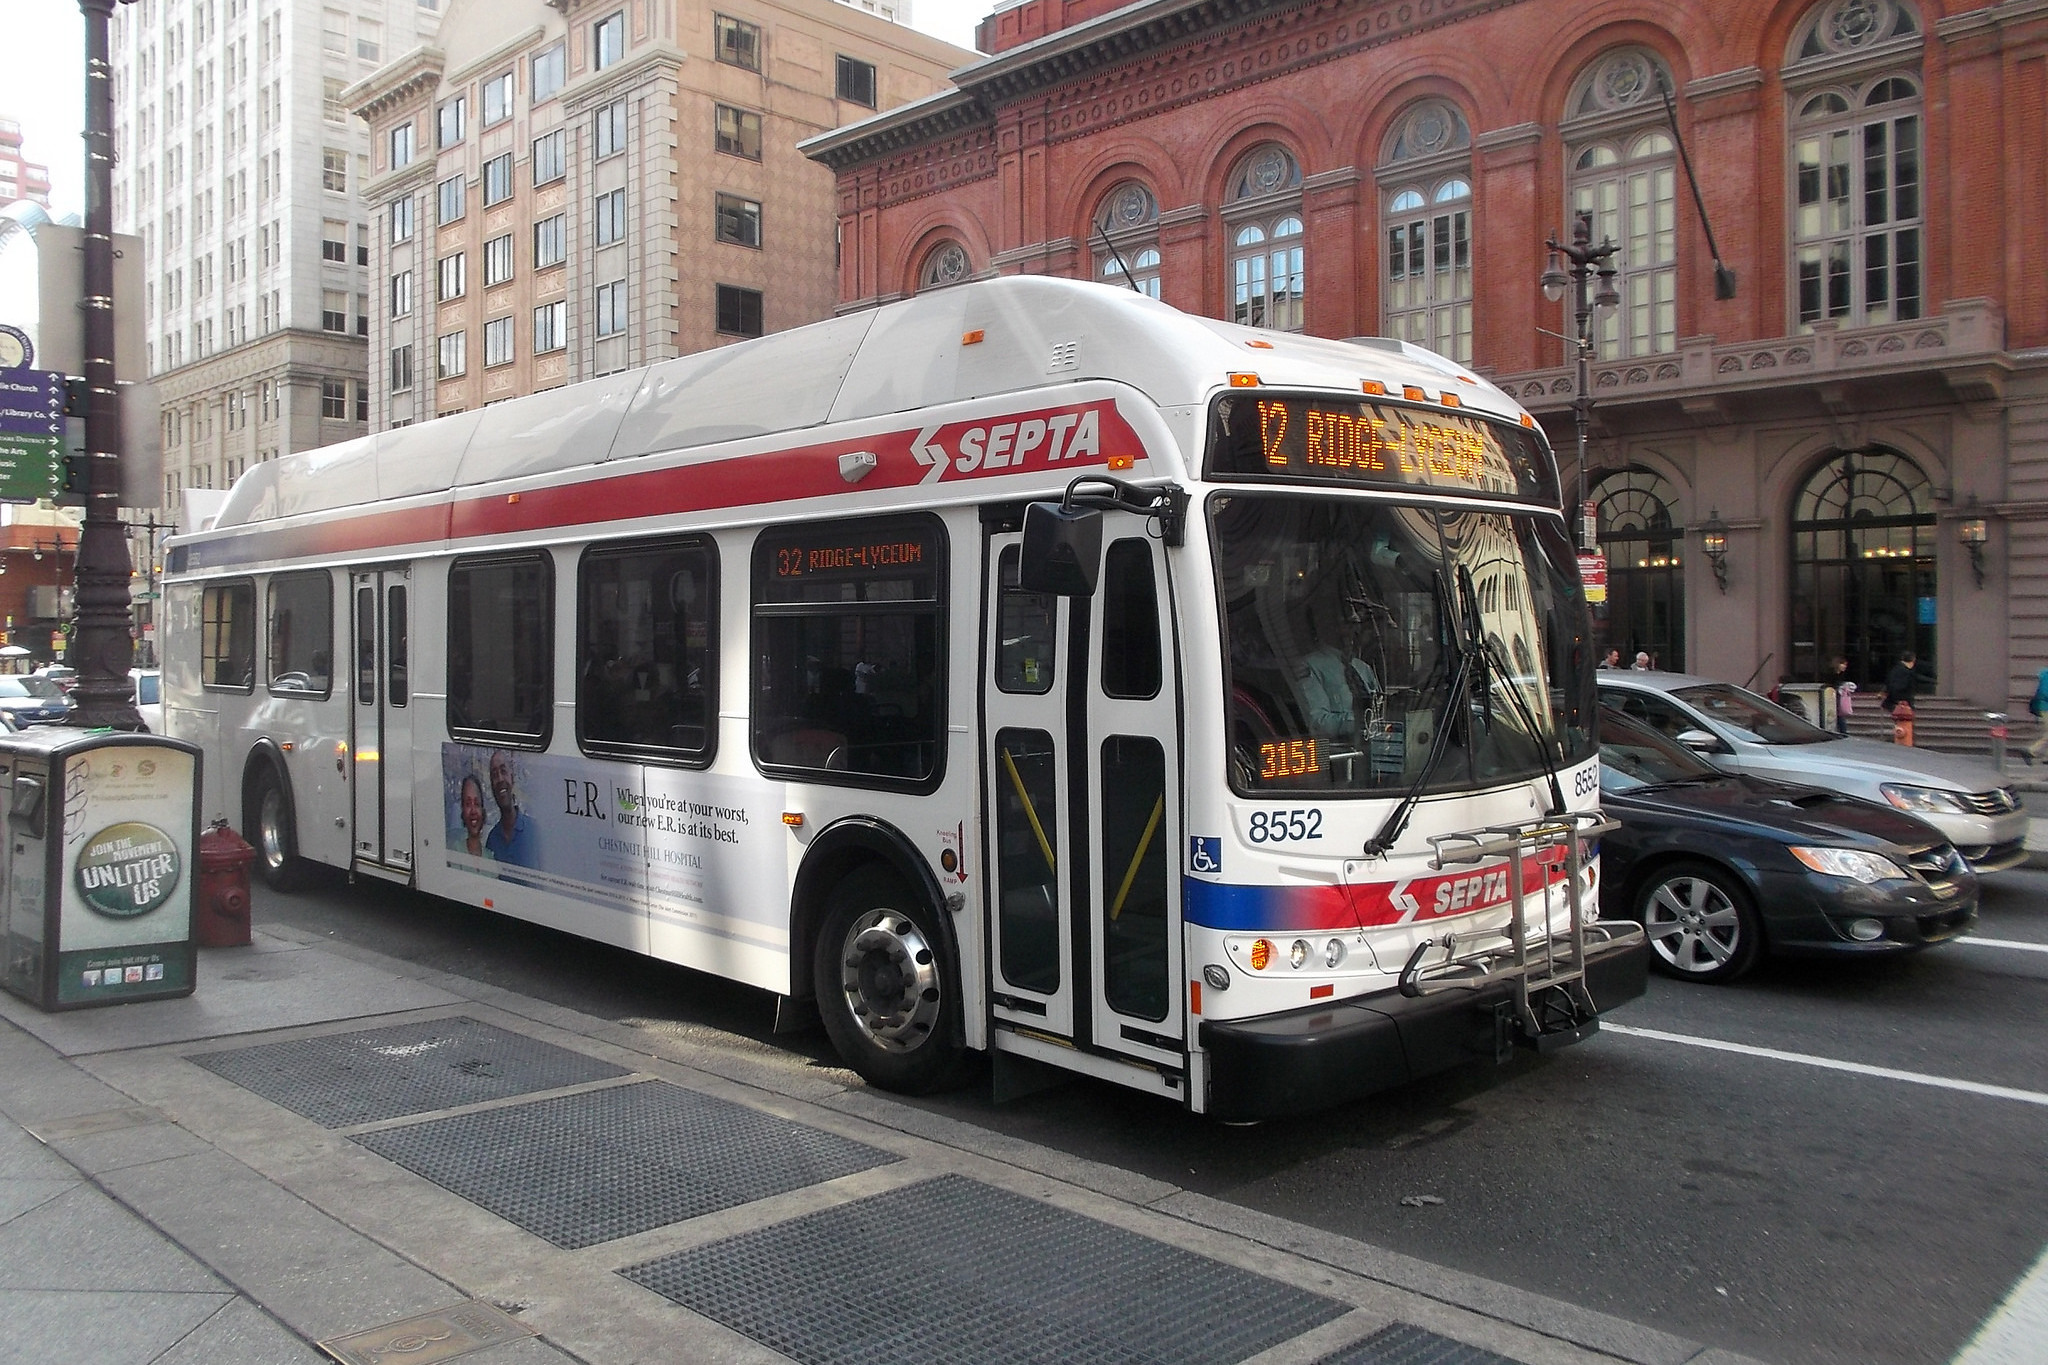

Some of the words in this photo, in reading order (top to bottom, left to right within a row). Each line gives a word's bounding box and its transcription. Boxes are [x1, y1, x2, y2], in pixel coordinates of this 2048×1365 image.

[11, 383, 39, 392] Church
[34, 410, 47, 419] Co.
[10, 447, 28, 456] Arts
[955, 410, 1100, 473] SEPTA
[1307, 411, 1484, 480] RIDGE-LYCEUM
[777, 548, 803, 577] 32
[808, 542, 922, 570] RIDGE-LYCEUM
[1260, 738, 1321, 779] 3151
[1575, 764, 1598, 797] 8552
[564, 778, 606, 821] E.R.
[616, 787, 646, 807] When
[647, 793, 676, 812] you're
[677, 799, 687, 813] at
[689, 801, 713, 819] your
[715, 805, 749, 825] worst,
[617, 812, 636, 826] our
[636, 815, 656, 829] new
[657, 814, 677, 833] E.R.
[678, 817, 687, 835] is
[688, 821, 698, 836] at
[699, 821, 712, 840] its
[714, 823, 739, 844] best.
[1249, 808, 1323, 843] 8552
[90, 841, 114, 857] JOIN
[114, 836, 132, 850] THE
[112, 841, 162, 861] MOVEMENT
[598, 837, 640, 857] CHESTNUT
[664, 849, 703, 869] HOSPITAL
[82, 853, 174, 888] UNLITTER
[133, 879, 161, 905] US
[1433, 868, 1507, 914] SEPTA
